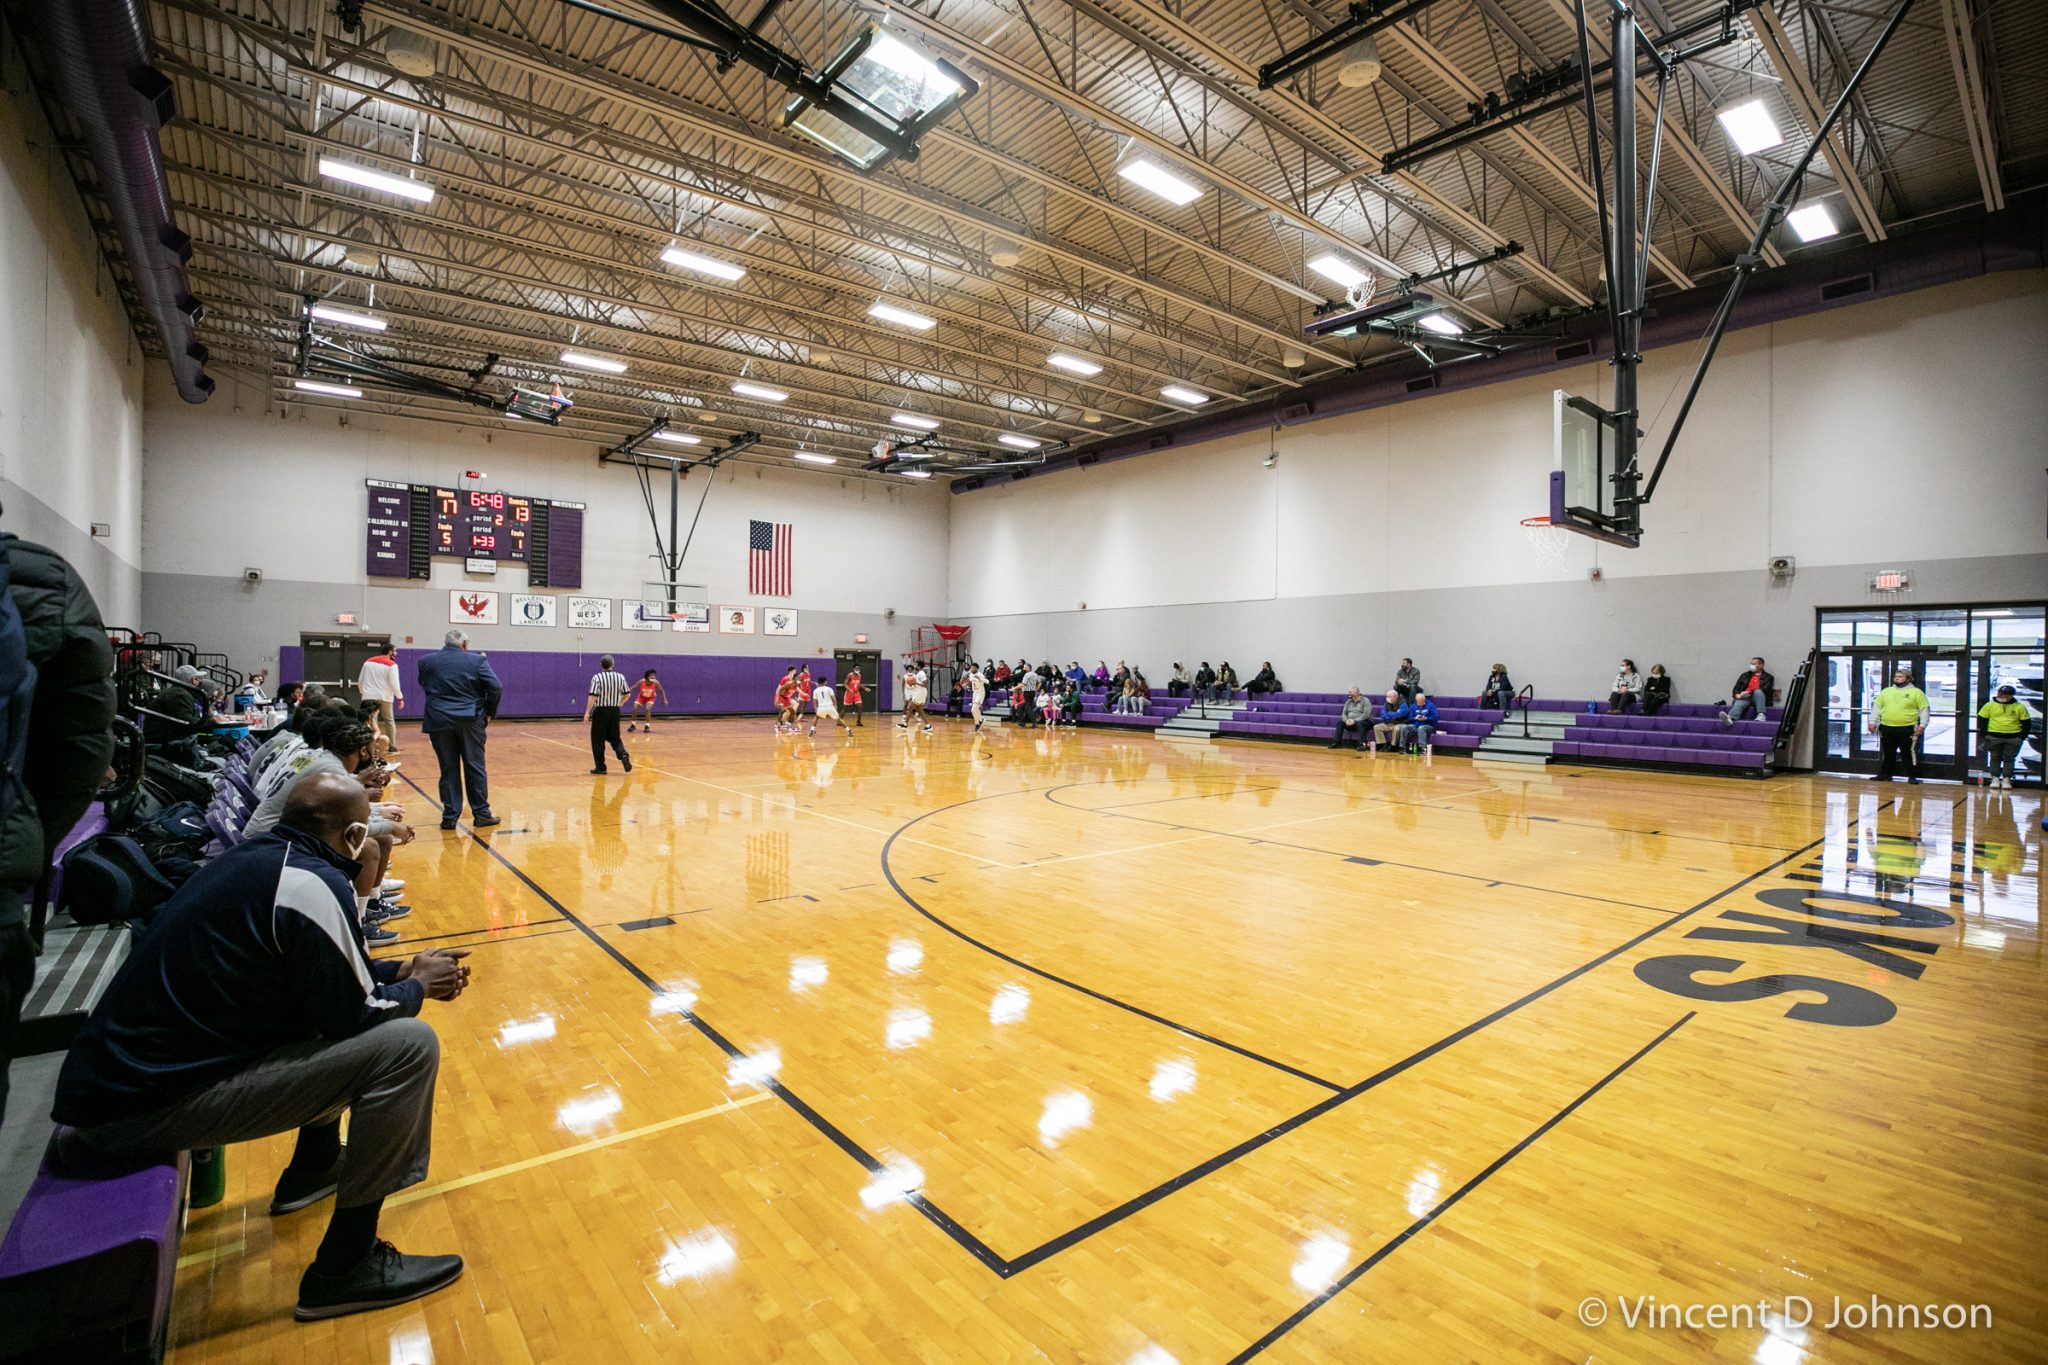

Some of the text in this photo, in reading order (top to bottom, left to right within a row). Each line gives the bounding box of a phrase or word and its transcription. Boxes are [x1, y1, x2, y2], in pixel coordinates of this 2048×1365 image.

[377, 496, 400, 505] WELCOME
[470, 491, 504, 509] 6:48
[443, 499, 458, 514] 17
[515, 506, 529, 522] 13
[495, 514, 504, 526] 2
[371, 528, 387, 537] HOME
[381, 540, 391, 548] THE
[1878, 575, 1897, 588] EXIT
[515, 595, 553, 605] BELLEVILLE
[572, 599, 607, 608] BELLEVILLE
[576, 611, 603, 619] WEST
